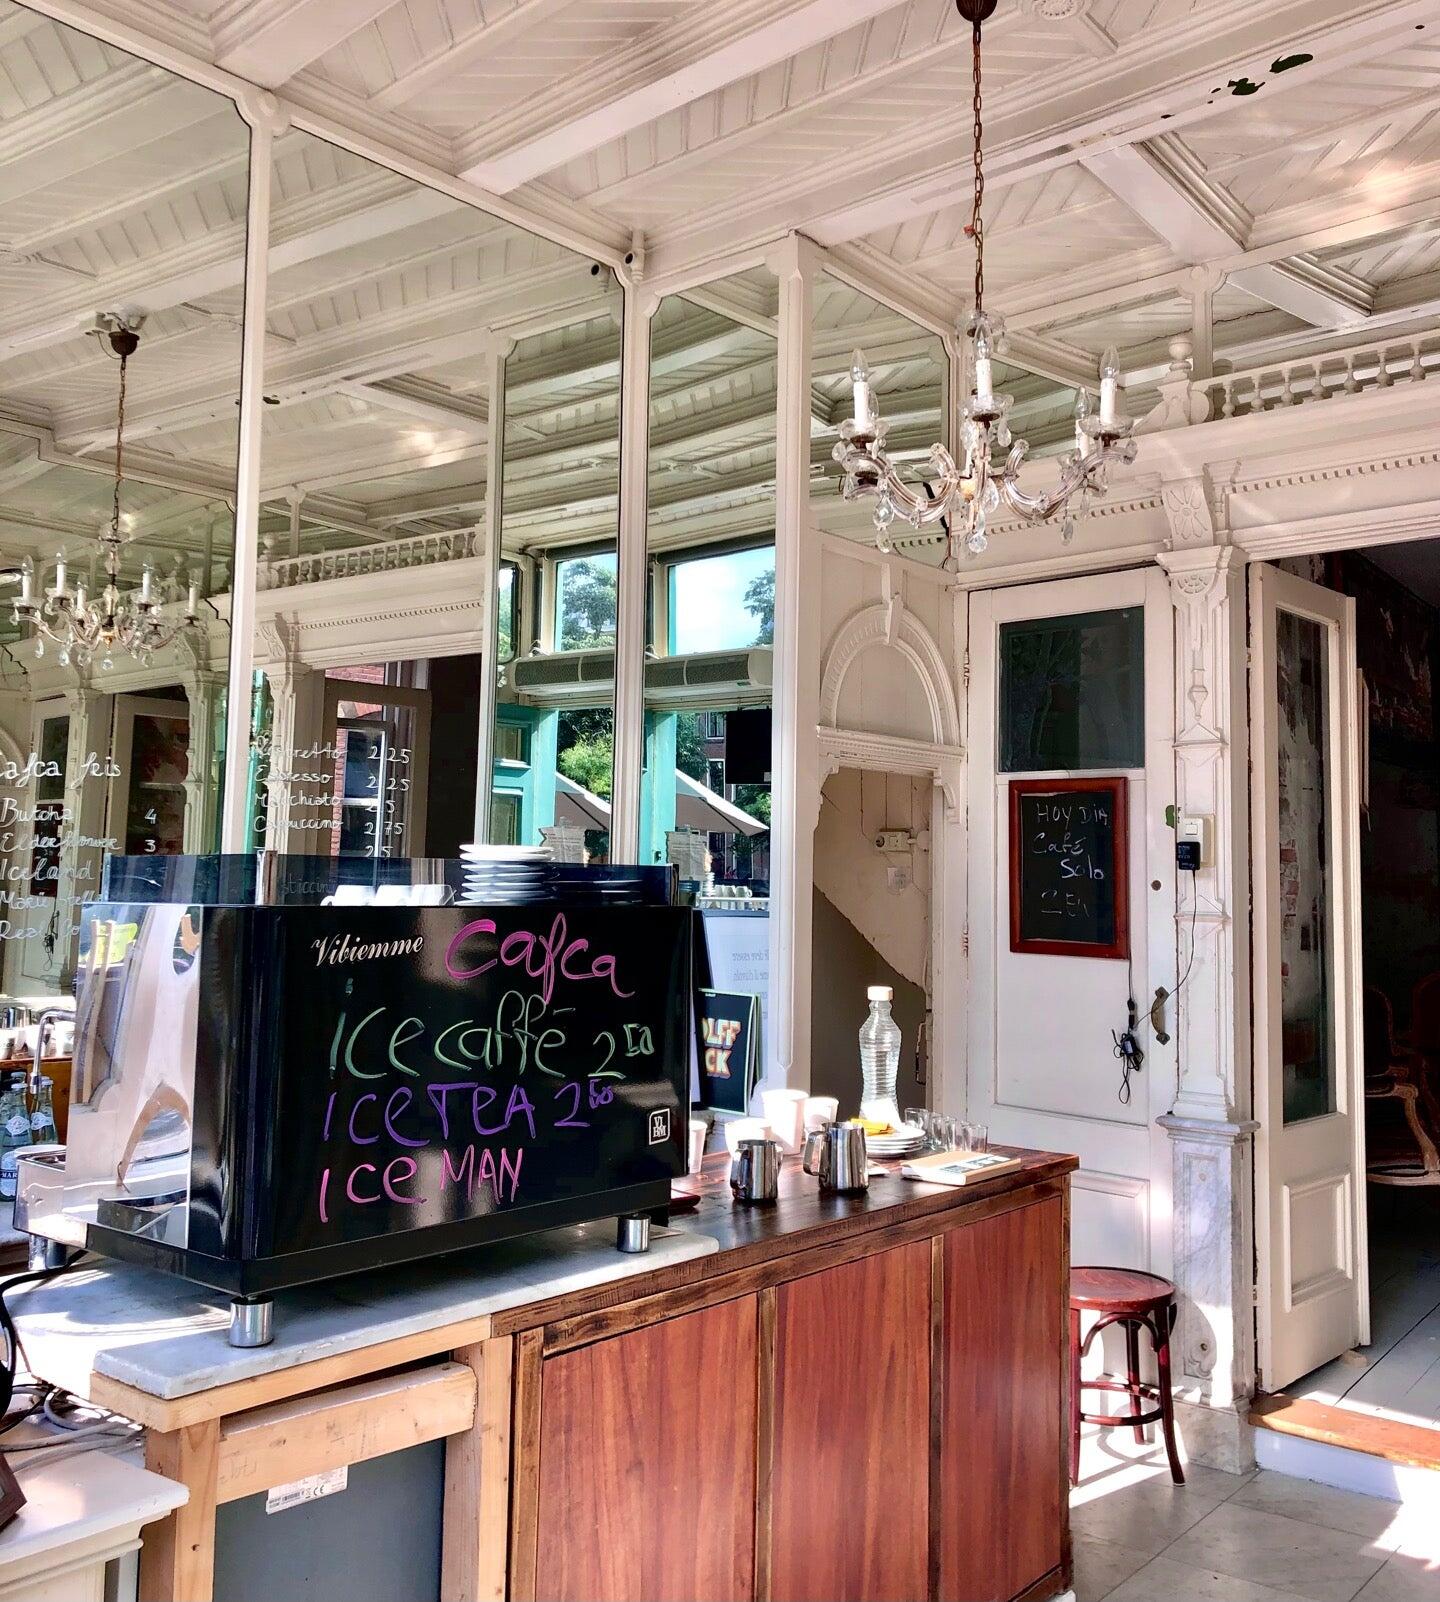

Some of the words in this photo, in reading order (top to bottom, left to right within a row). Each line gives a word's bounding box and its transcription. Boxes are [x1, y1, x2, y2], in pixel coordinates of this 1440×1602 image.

[144, 808, 157, 825] 4
[1036, 803, 1072, 829] HOY
[144, 839, 156, 852] 3
[310, 934, 424, 967] Vibiemme
